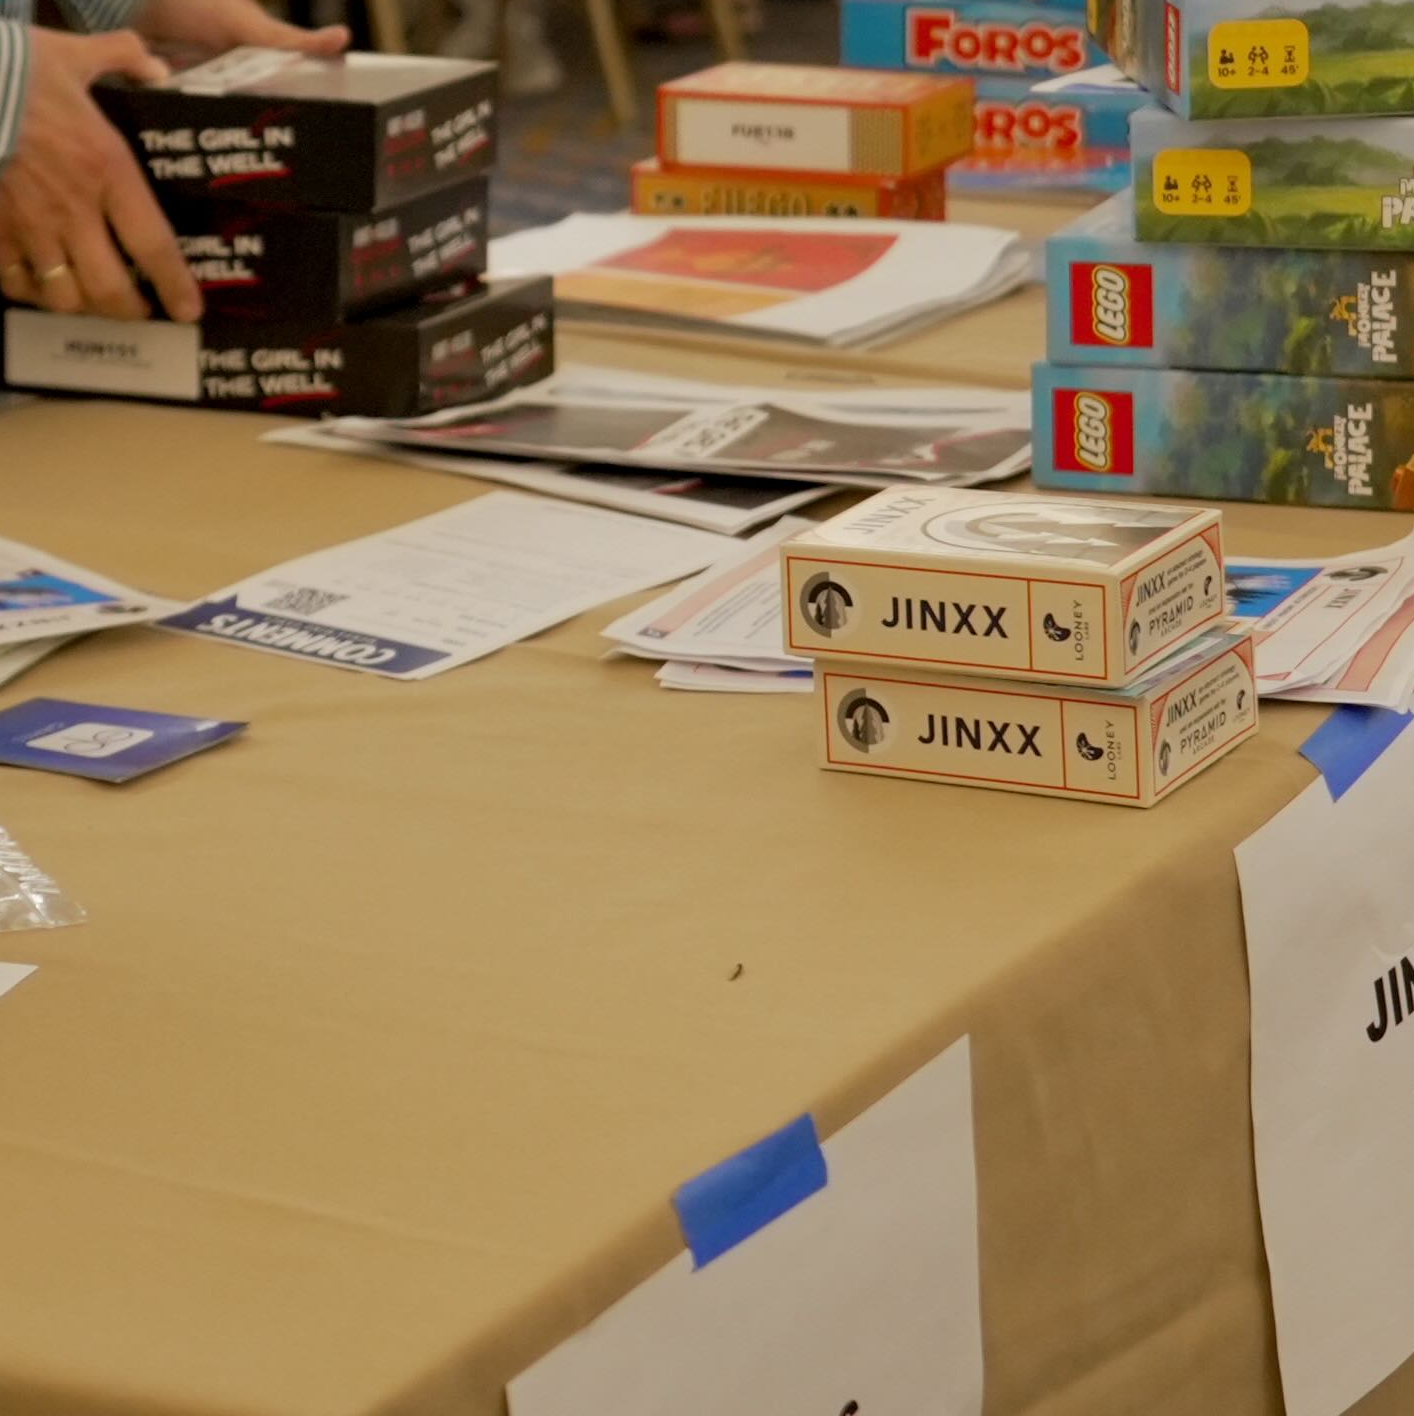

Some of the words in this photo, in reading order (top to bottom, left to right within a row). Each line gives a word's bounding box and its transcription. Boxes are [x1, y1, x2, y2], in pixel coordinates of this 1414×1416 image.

[906, 7, 1084, 73] FOROS
[1218, 67, 1236, 77] 10+
[1248, 66, 1269, 76] 2-4
[139, 128, 194, 152] THE
[198, 127, 260, 151] GIRL
[263, 125, 295, 149] IN
[975, 99, 1082, 150] ROS
[148, 154, 204, 180] THE
[206, 151, 285, 176] WELL
[1163, 194, 1180, 204] 10+
[1191, 194, 1212, 204] 2-4
[233, 234, 265, 256] IN
[1092, 265, 1130, 344] LEGO
[1371, 269, 1398, 364] PALACE
[200, 347, 244, 371] THE
[250, 348, 311, 370] GIRL
[314, 346, 344, 370] IN
[203, 374, 256, 398] THE
[258, 371, 335, 396] WELL
[1075, 392, 1112, 471] LEGO
[1347, 402, 1374, 497] PALACE
[1135, 570, 1166, 608] JINXX
[881, 596, 1009, 640] JINXX
[1073, 599, 1084, 661] LOONEY
[1148, 595, 1195, 636] PYRAMID
[198, 612, 398, 666] COMMENTS
[1166, 688, 1197, 728] JINXX
[917, 713, 1043, 758] JINXX
[1105, 719, 1116, 781] LOONEY
[1179, 711, 1227, 755] PYRAMID
